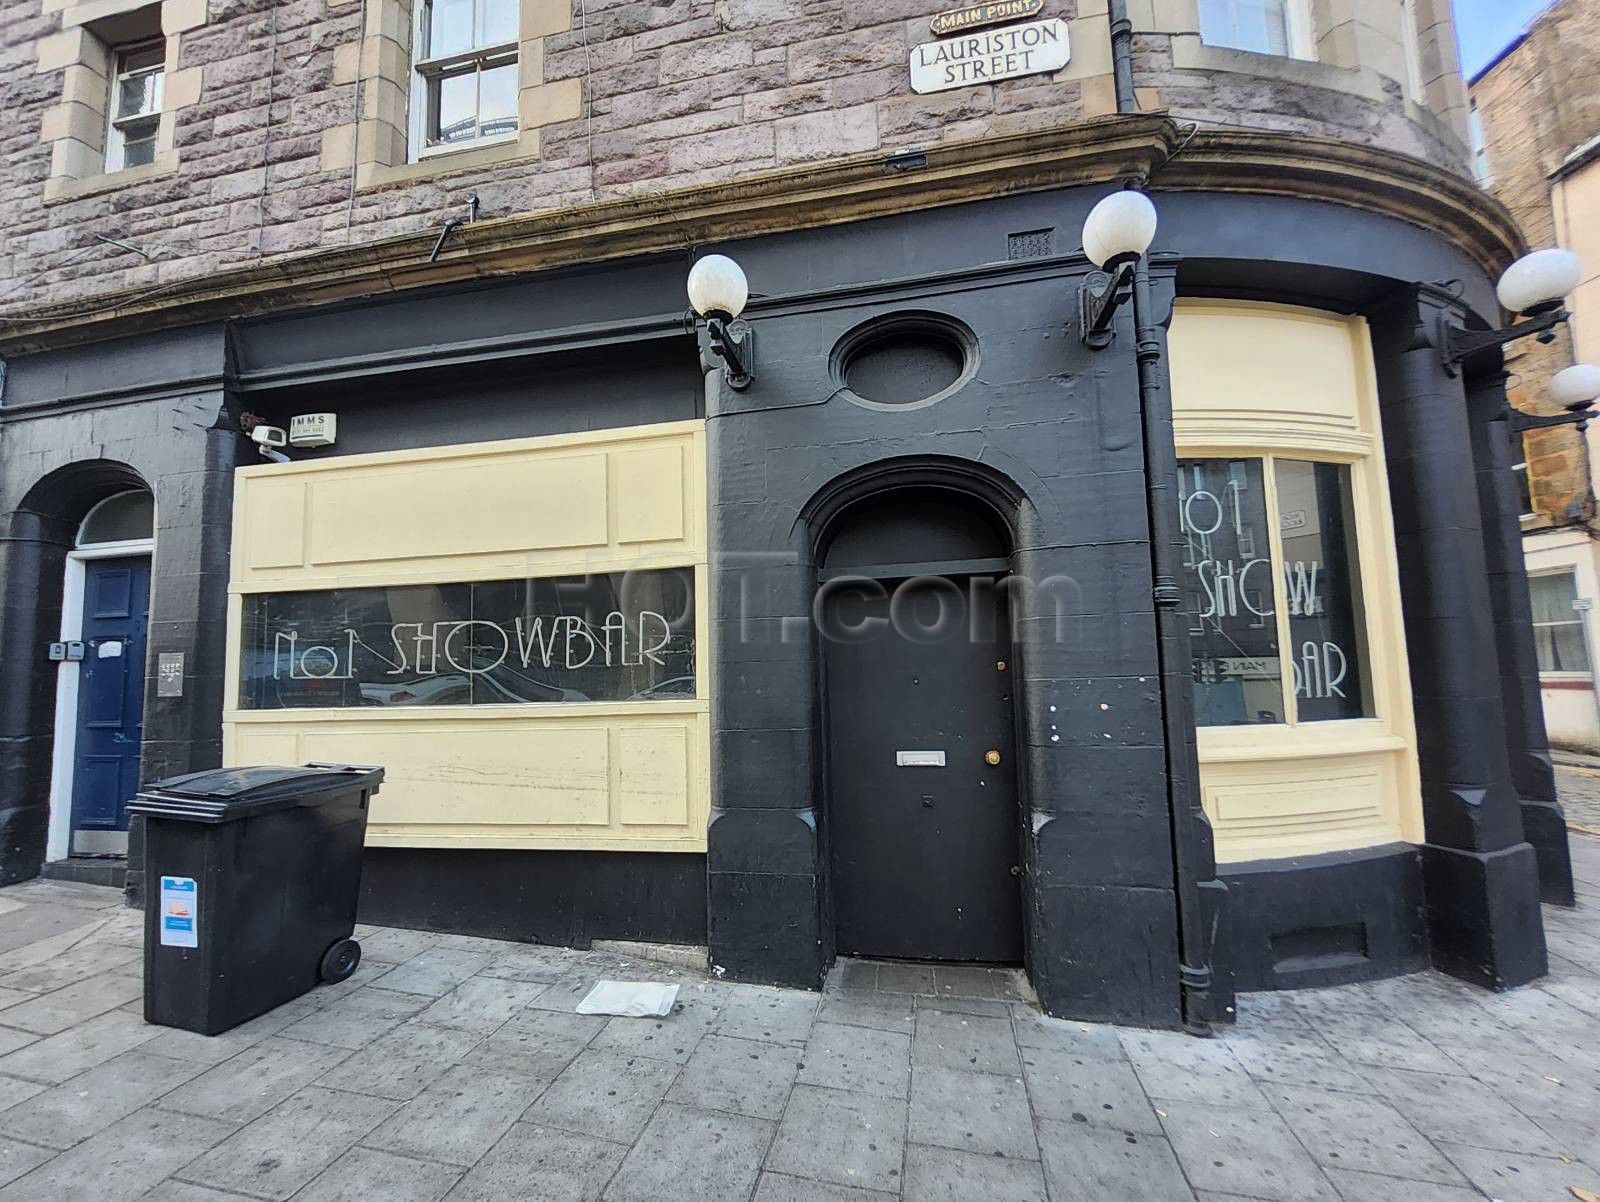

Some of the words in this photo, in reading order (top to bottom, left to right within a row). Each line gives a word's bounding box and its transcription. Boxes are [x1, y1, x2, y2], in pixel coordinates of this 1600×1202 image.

[940, 9, 981, 29] MAIN
[986, 0, 1032, 18] POINT
[919, 23, 1059, 67] LAURISTON
[944, 50, 1034, 84] STREET
